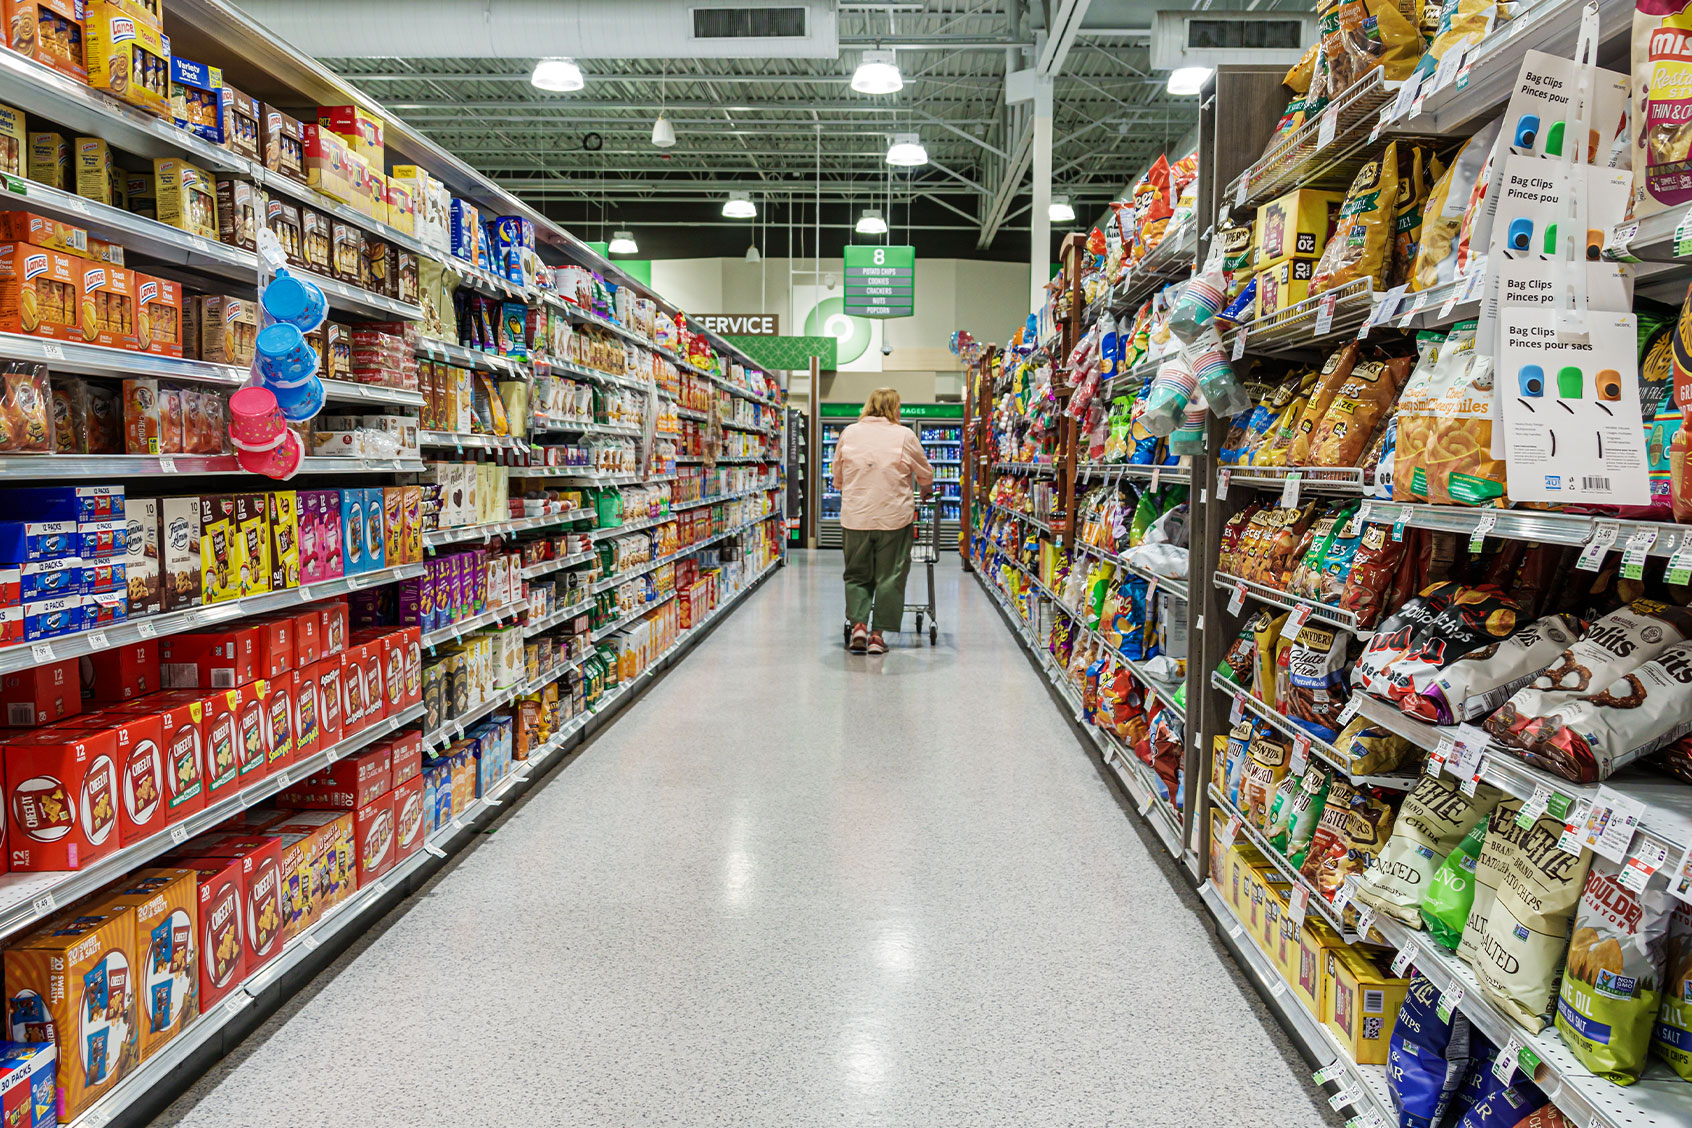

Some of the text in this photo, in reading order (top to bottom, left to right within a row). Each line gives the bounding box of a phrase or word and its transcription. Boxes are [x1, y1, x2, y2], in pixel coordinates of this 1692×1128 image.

[112, 19, 134, 35] Lance
[177, 60, 200, 73] Variety
[181, 70, 198, 81] Pack
[1526, 72, 1563, 90] Bag Clips
[1521, 85, 1569, 105] Pinces pour
[1652, 103, 1681, 119] THIN &
[318, 117, 331, 127] RITZ
[128, 180, 145, 190] nce
[1511, 176, 1553, 189] Bag Clips
[1507, 189, 1559, 204] Pinces pou
[1298, 239, 1314, 250] 20
[54, 255, 69, 267] Toast
[873, 249, 885, 265] 8
[26, 257, 47, 273] Lance
[1295, 263, 1306, 278] 20
[86, 272, 105, 287] Lance
[111, 269, 125, 280] Toast
[868, 277, 889, 285] COOKIES
[162, 282, 173, 292] Toast
[866, 287, 892, 295] CRACKERS
[1508, 279, 1552, 290] Bag Clips
[140, 285, 157, 299] Lance
[1506, 293, 1539, 302] Pinces
[872, 297, 886, 305] NUTS
[227, 303, 241, 317] Lance
[1509, 326, 1555, 338] Bag Clips
[1509, 339, 1593, 351] Pinces pour sacs
[138, 415, 147, 446] CHEDDAR
[145, 503, 154, 513] 10
[190, 502, 198, 512] 10
[202, 500, 212, 515] 12
[237, 499, 246, 513] 12
[48, 522, 62, 531] PACKS
[101, 522, 112, 530] PACKS
[172, 533, 188, 549] Amos
[39, 560, 64, 571] 12 PACKS
[98, 557, 111, 565] PACKS
[44, 600, 65, 610] 12 PACKS
[1298, 630, 1332, 646] SNYDER'S
[137, 648, 145, 658] 12
[1289, 649, 1326, 667] Gluten
[53, 668, 63, 680] 12
[1292, 660, 1319, 677] Free
[236, 690, 242, 699] 12
[205, 702, 212, 712] 12
[163, 713, 172, 725] 12
[119, 729, 129, 741] 12
[76, 744, 86, 756] 12
[345, 793, 354, 806] 20
[1405, 816, 1440, 845] CHIPS
[13, 850, 25, 866] 12
[243, 858, 252, 868] 20
[1513, 857, 1534, 880] BRAND
[253, 864, 275, 896] CHEEZ-IT
[201, 885, 210, 897] 20
[1517, 884, 1542, 912] CHIPS
[138, 895, 164, 918] 20 SWEET
[153, 900, 168, 916] SALTY
[1582, 869, 1643, 935] BOULDER
[211, 897, 234, 930] CHEEZ-IT
[1585, 894, 1626, 930] CANYON
[68, 936, 97, 962] 20 SWEET
[79, 941, 101, 961] & SALTY
[55, 957, 64, 971] 20
[1617, 977, 1634, 985] NON
[1575, 991, 1594, 1017] OIL
[1574, 1013, 1587, 1032] SALT
[1661, 1003, 1688, 1028] OIL
[1662, 1027, 1681, 1045] SALT
[1670, 1050, 1689, 1065] CHIPS
[1, 1063, 32, 1092] 30 PACKS
